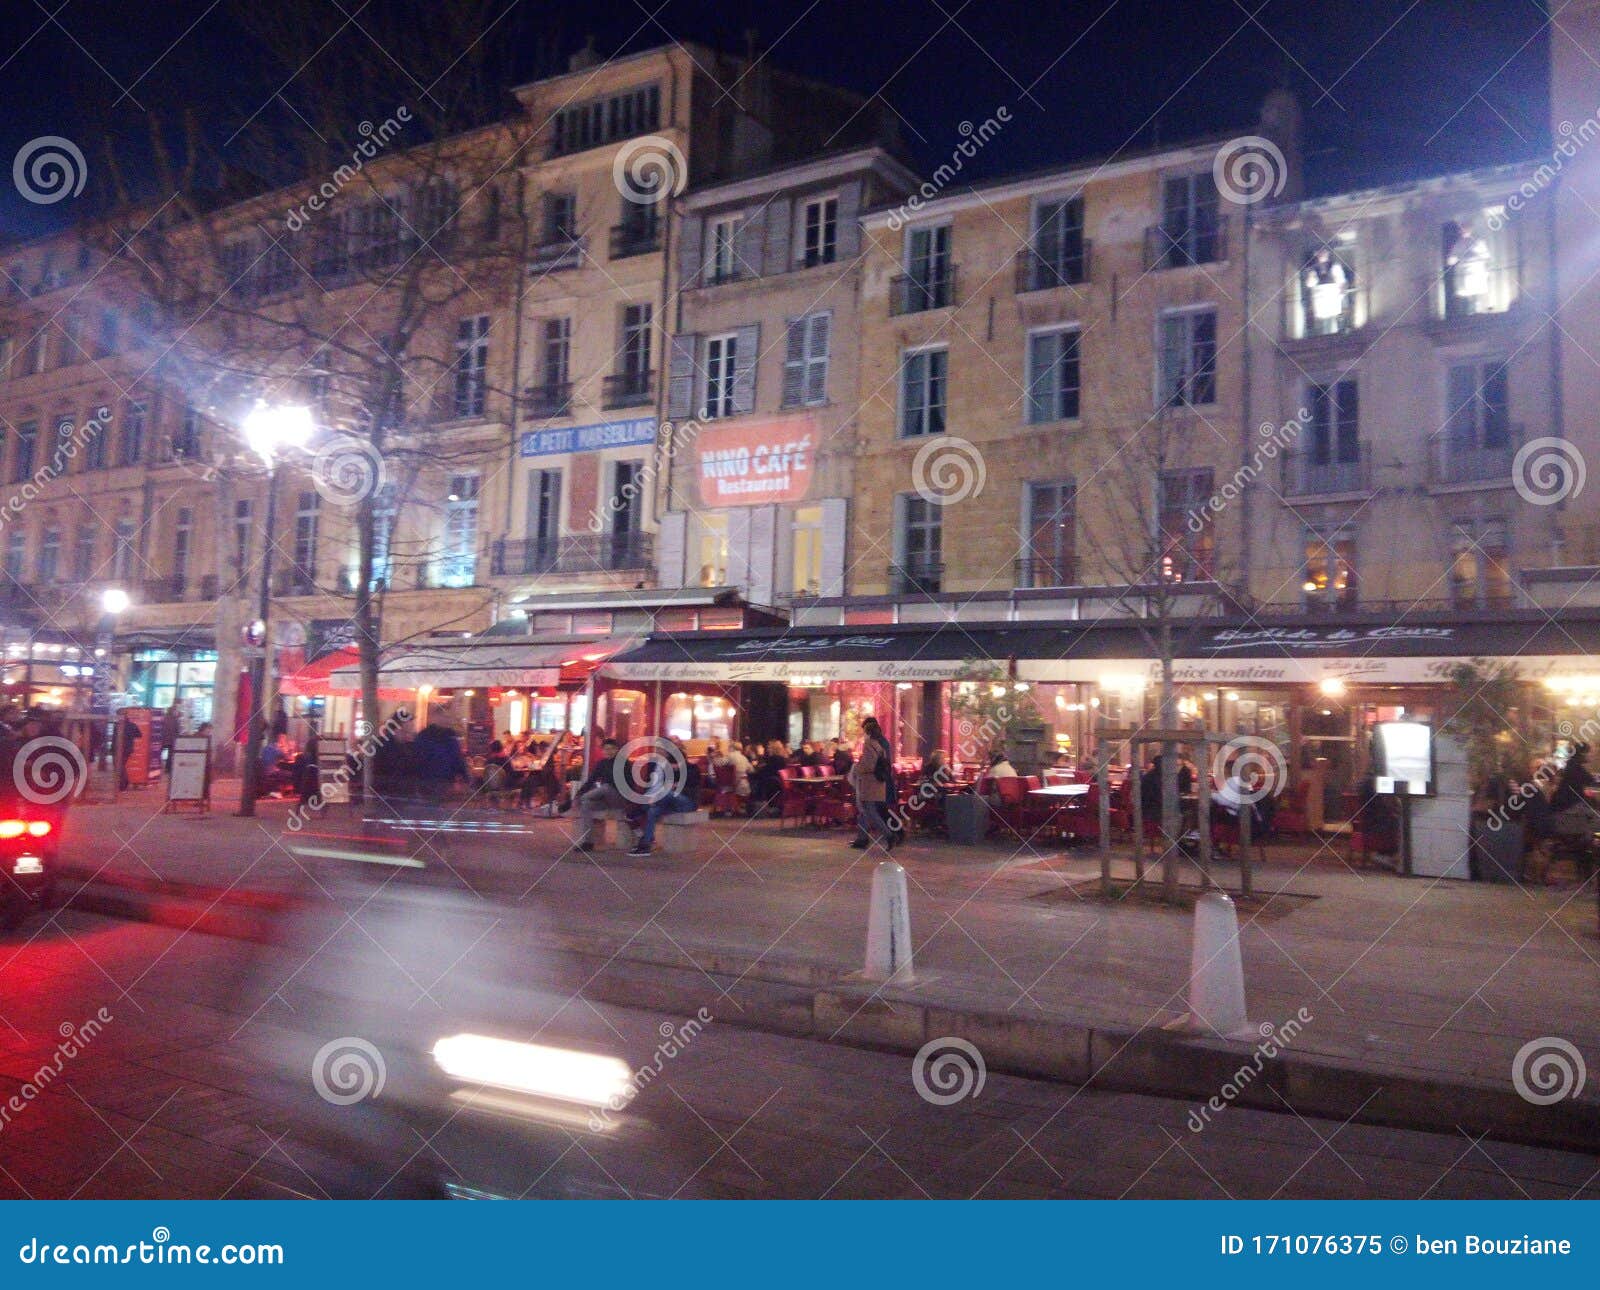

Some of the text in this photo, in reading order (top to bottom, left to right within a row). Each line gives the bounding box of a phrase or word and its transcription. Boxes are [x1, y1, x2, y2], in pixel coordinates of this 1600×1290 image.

[540, 430, 574, 451] PETIT
[702, 434, 811, 478] NINO CAFÉ
[717, 475, 790, 495] Restaurant
[1150, 661, 1286, 680] Sevice continu
